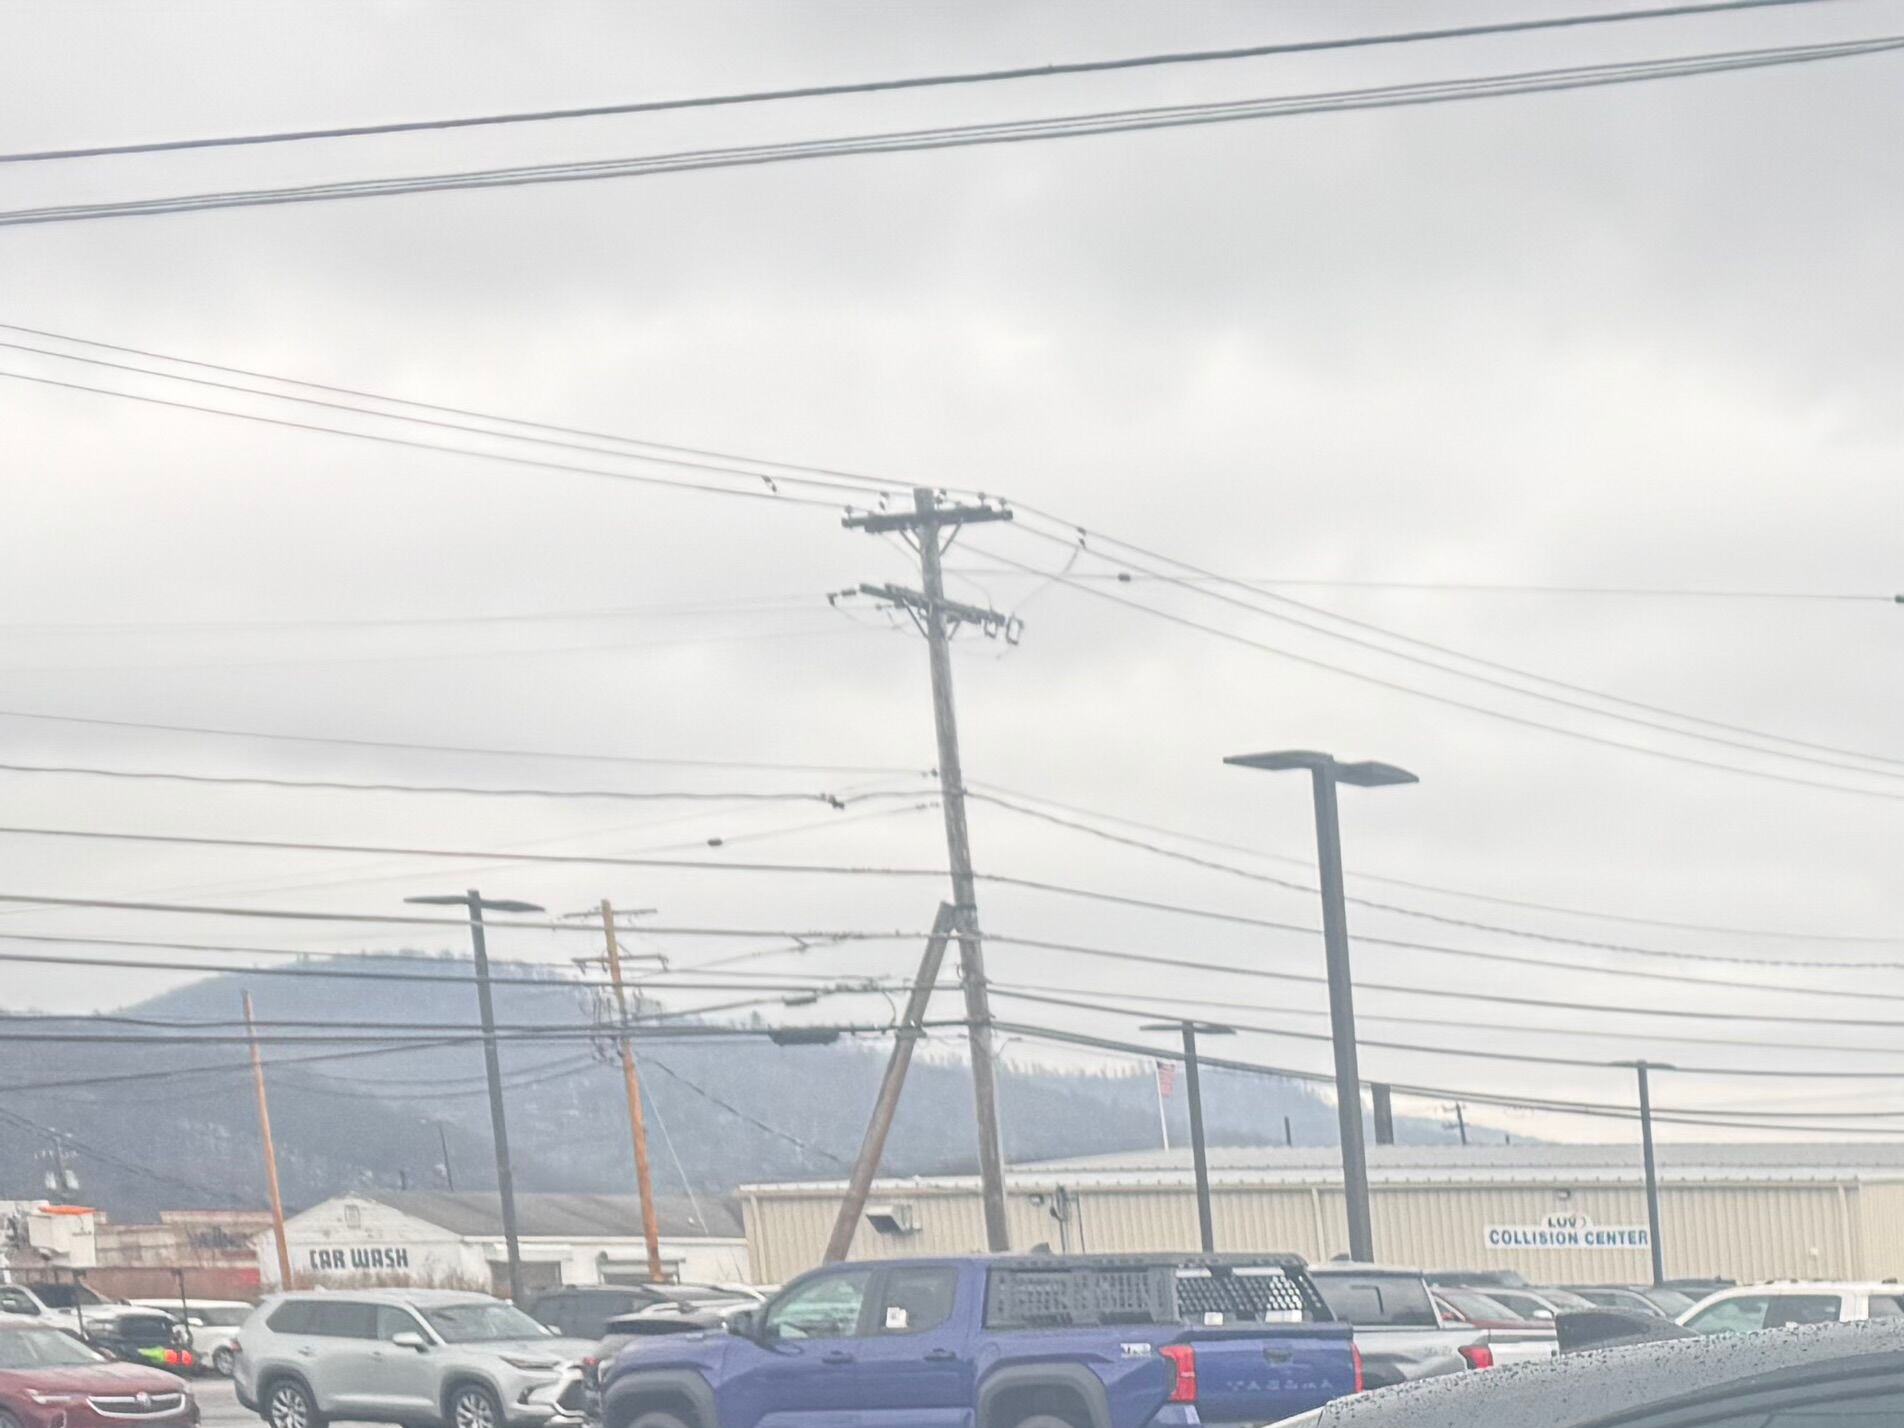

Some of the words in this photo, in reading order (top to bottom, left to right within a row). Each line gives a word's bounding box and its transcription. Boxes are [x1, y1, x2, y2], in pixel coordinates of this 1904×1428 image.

[1548, 1216, 1578, 1229] LUV
[1489, 1229, 1579, 1246] COLLISION
[1584, 1229, 1649, 1246] CENTER
[309, 1249, 346, 1271] CAR
[351, 1247, 409, 1269] WASH
